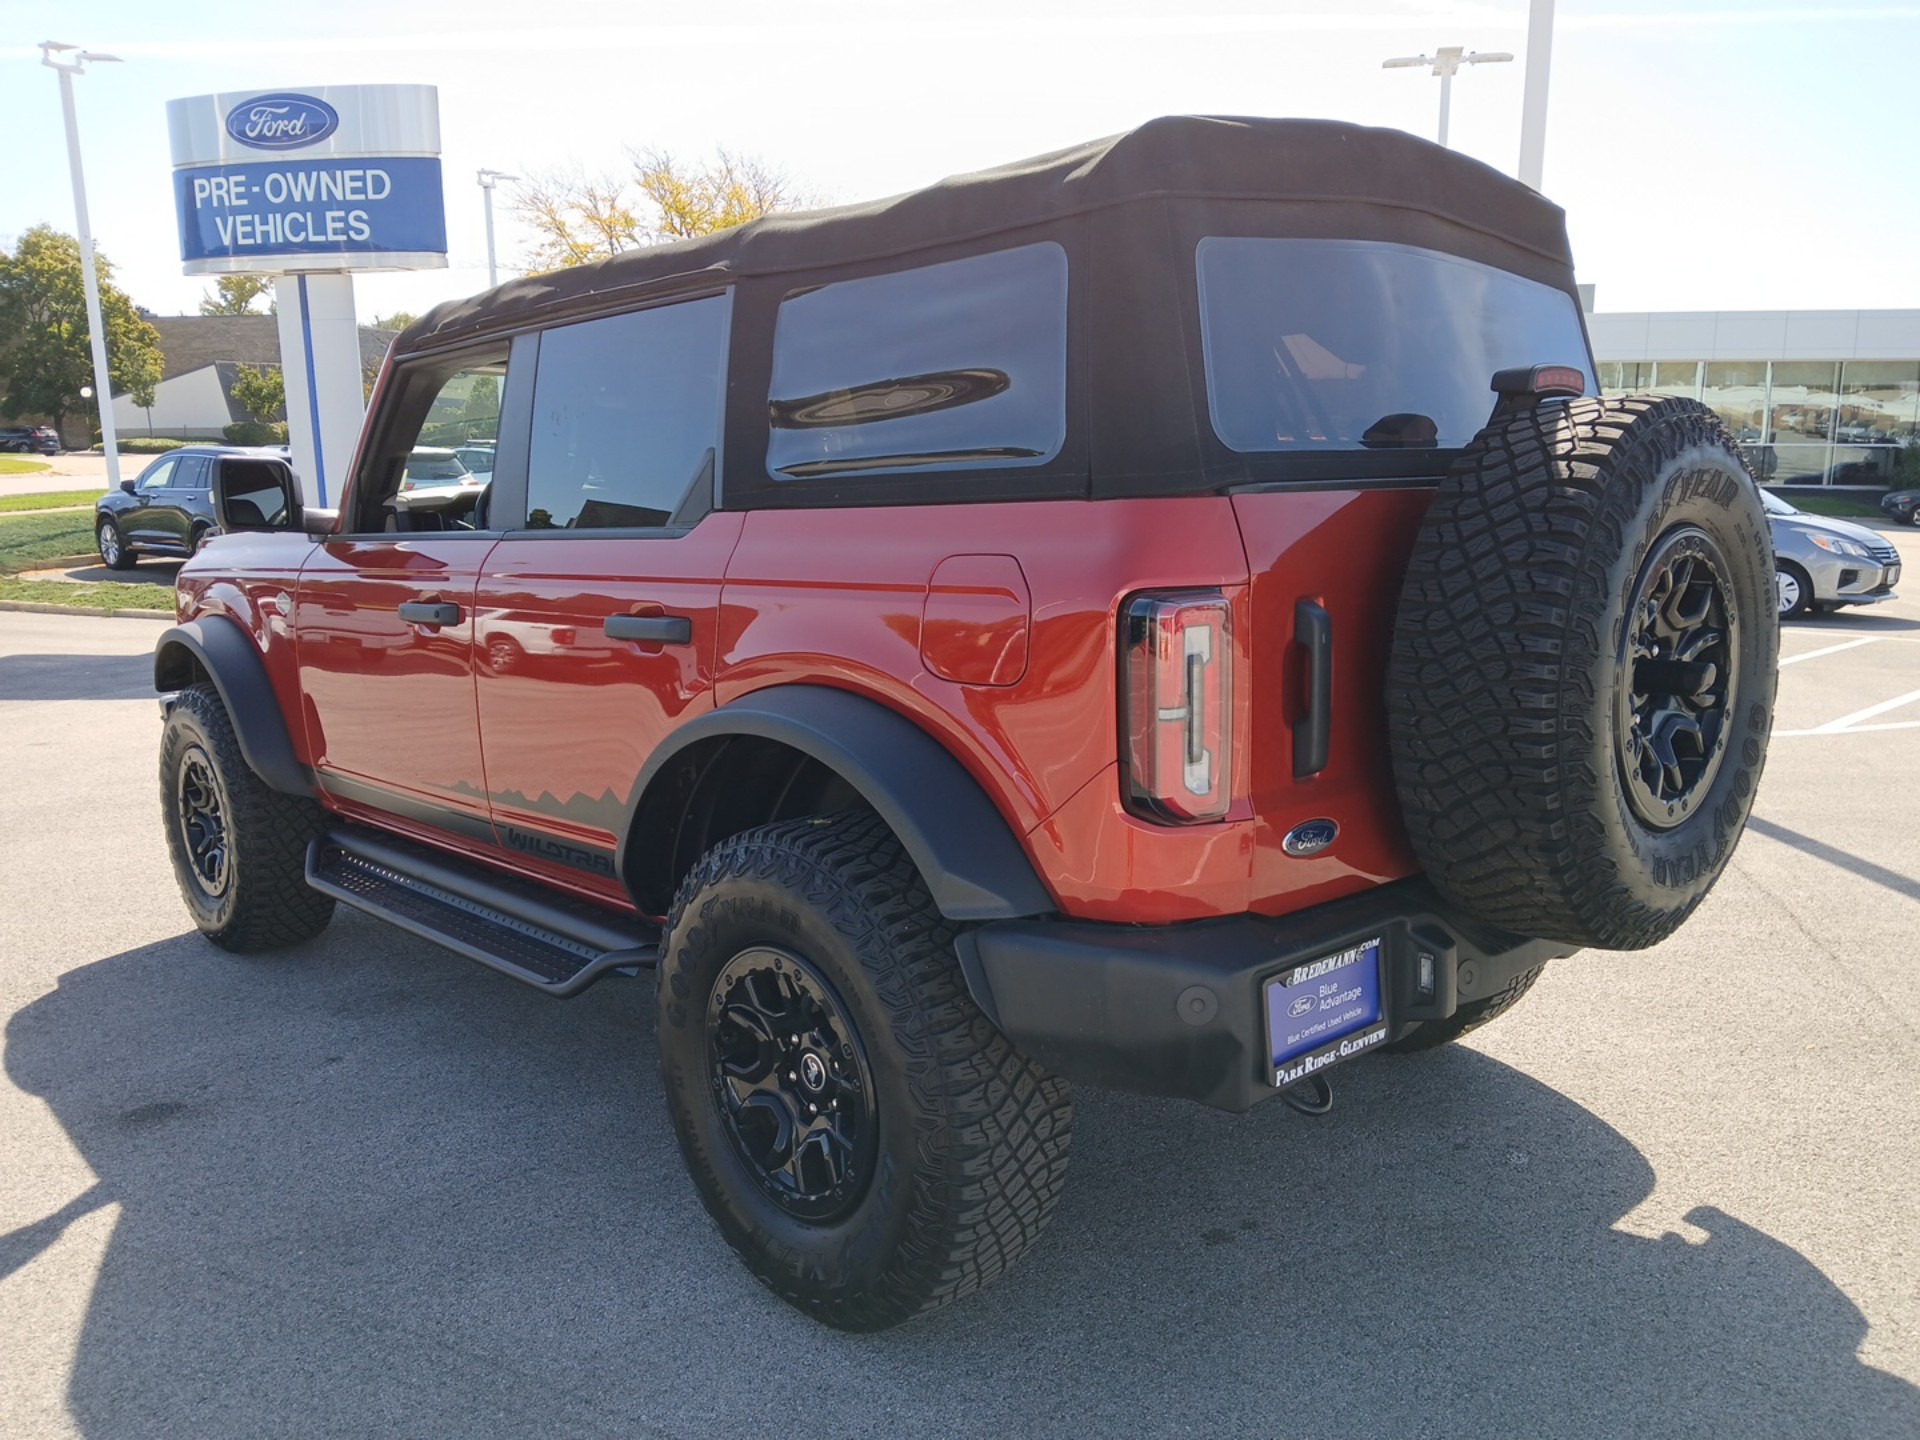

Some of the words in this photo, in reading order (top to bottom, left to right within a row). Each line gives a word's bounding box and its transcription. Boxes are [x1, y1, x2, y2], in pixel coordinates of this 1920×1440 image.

[245, 106, 306, 138] Ford
[194, 169, 391, 209] PRE-OWNED
[215, 210, 370, 246] VEHICLES
[1319, 982, 1338, 998] Blue
[1319, 986, 1362, 1012] Advantage
[1287, 1033, 1301, 1045] Blue
[1301, 1021, 1326, 1039] Certified
[1327, 1014, 1342, 1028] Used
[1342, 1007, 1362, 1021] Vehicle
[1275, 1063, 1304, 1088] PARK
